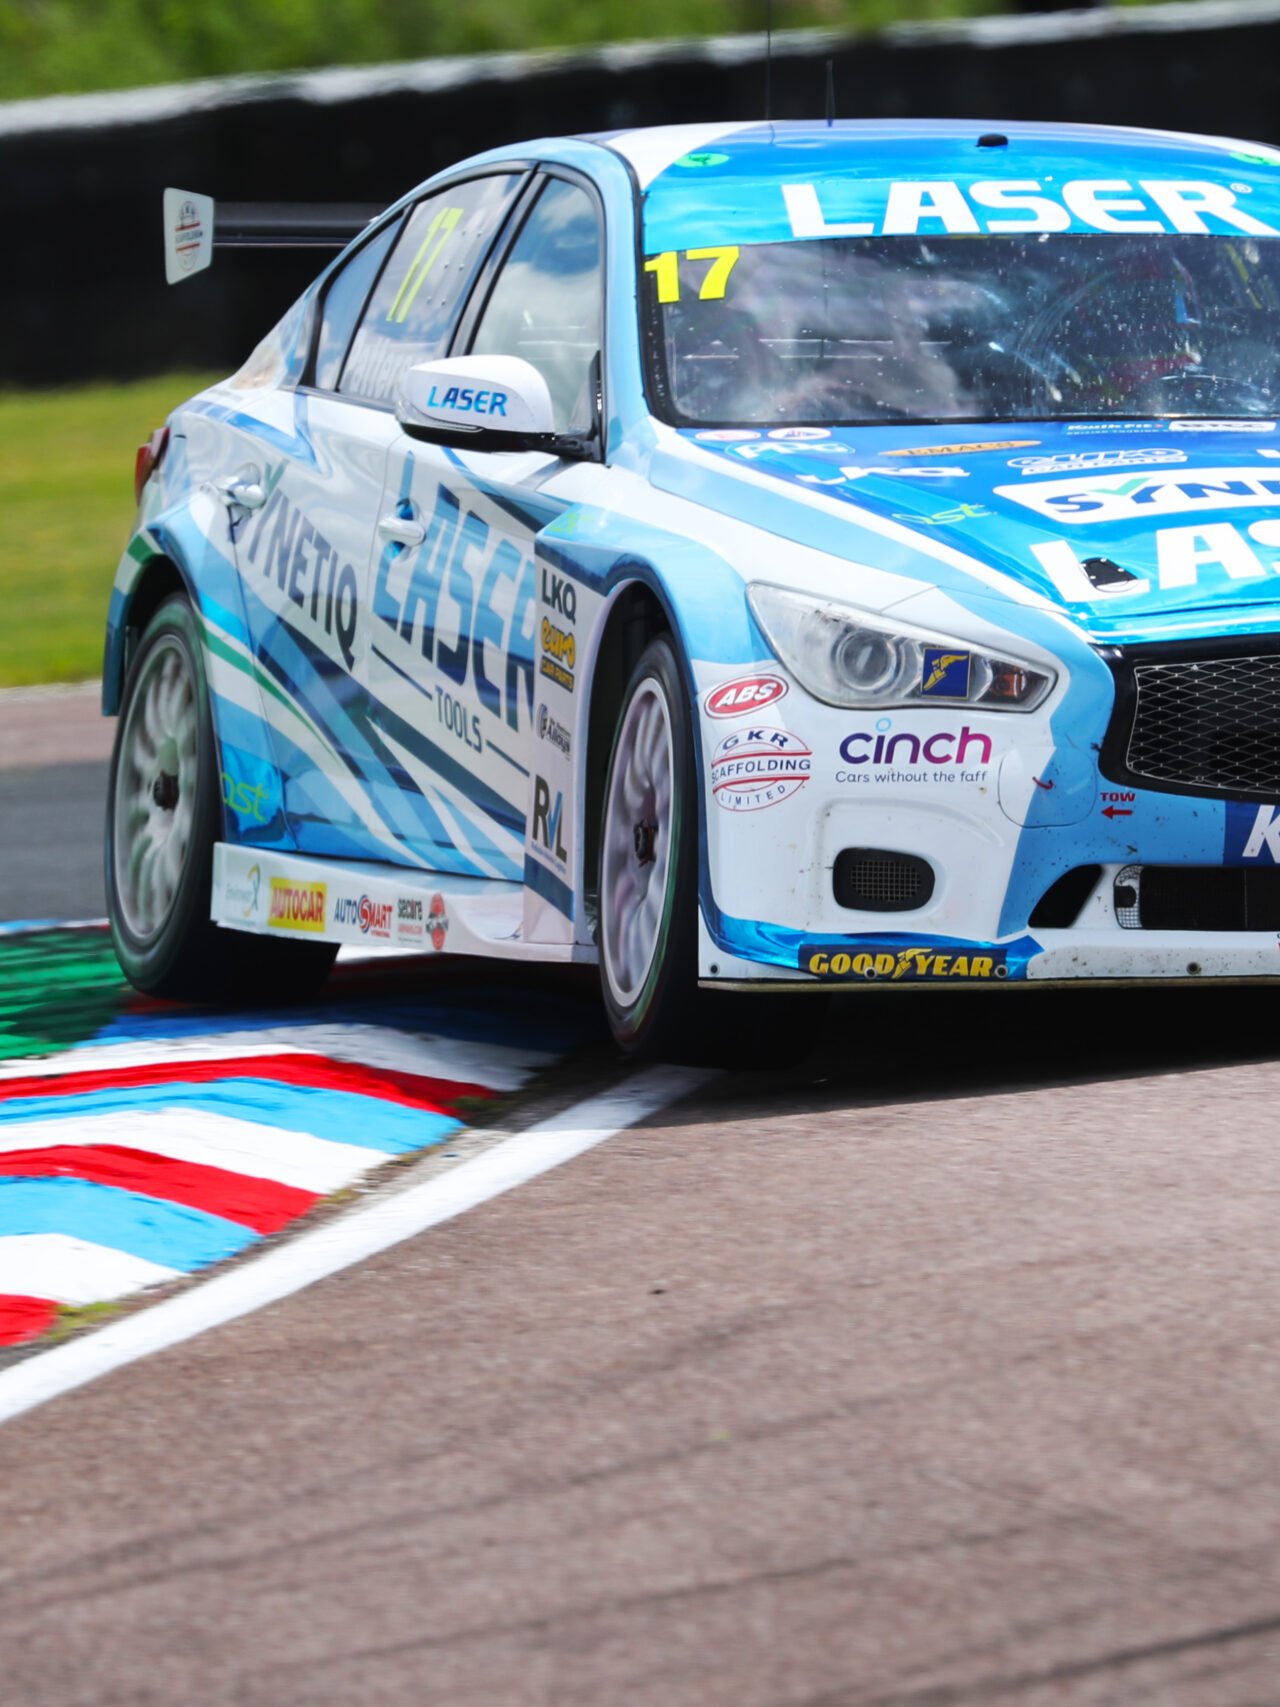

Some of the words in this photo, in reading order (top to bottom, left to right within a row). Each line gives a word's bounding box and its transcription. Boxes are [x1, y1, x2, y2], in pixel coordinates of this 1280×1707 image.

[644, 246, 740, 303] 17
[428, 386, 507, 416] LASER
[542, 568, 576, 626] LKQ
[716, 682, 776, 708] ABS
[435, 686, 483, 753] TOOLS
[839, 717, 993, 765] cinch
[711, 759, 811, 784] SCAFFOLDING
[835, 770, 870, 783] Cars
[874, 769, 932, 783] without
[934, 769, 956, 782] the
[960, 769, 987, 782] faff
[720, 785, 786, 806] LIMITED
[1100, 792, 1136, 802] TOW
[271, 887, 324, 923] AUTOCAR
